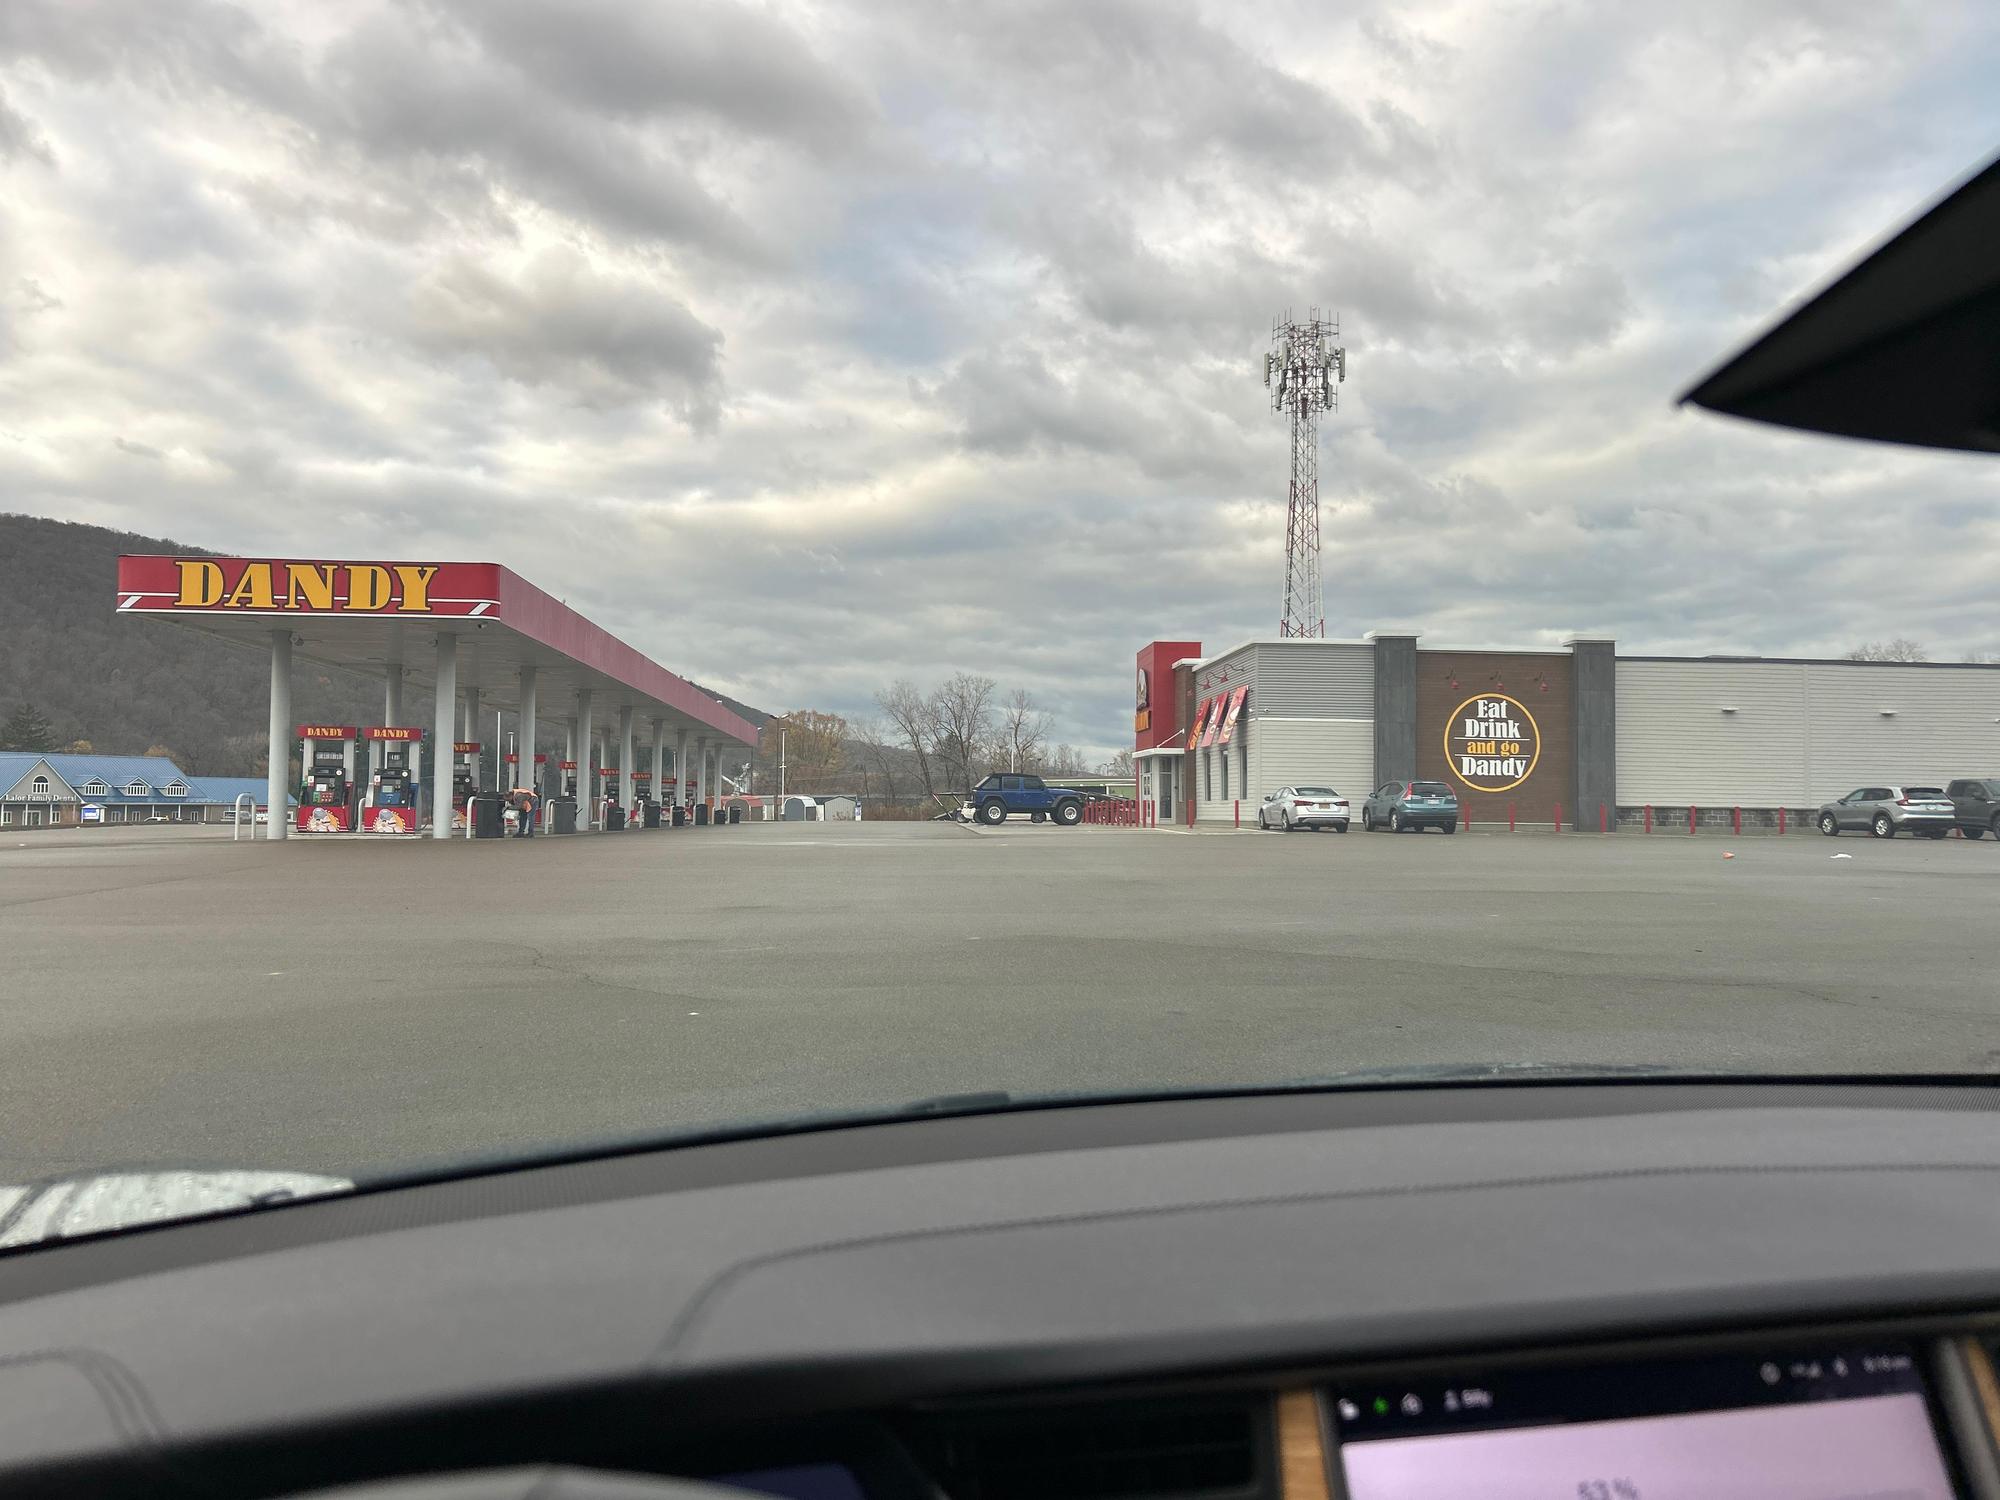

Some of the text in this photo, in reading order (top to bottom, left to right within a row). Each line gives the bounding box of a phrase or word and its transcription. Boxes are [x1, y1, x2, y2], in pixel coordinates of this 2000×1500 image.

[173, 560, 439, 612] DANDY
[1476, 699, 1508, 719] Eat
[306, 726, 344, 737] DANDY
[373, 728, 410, 738] DANDY
[1464, 718, 1521, 739] Drink
[1466, 740, 1520, 757] and go
[1461, 756, 1527, 779] Dandy
[28, 794, 51, 804] Family
